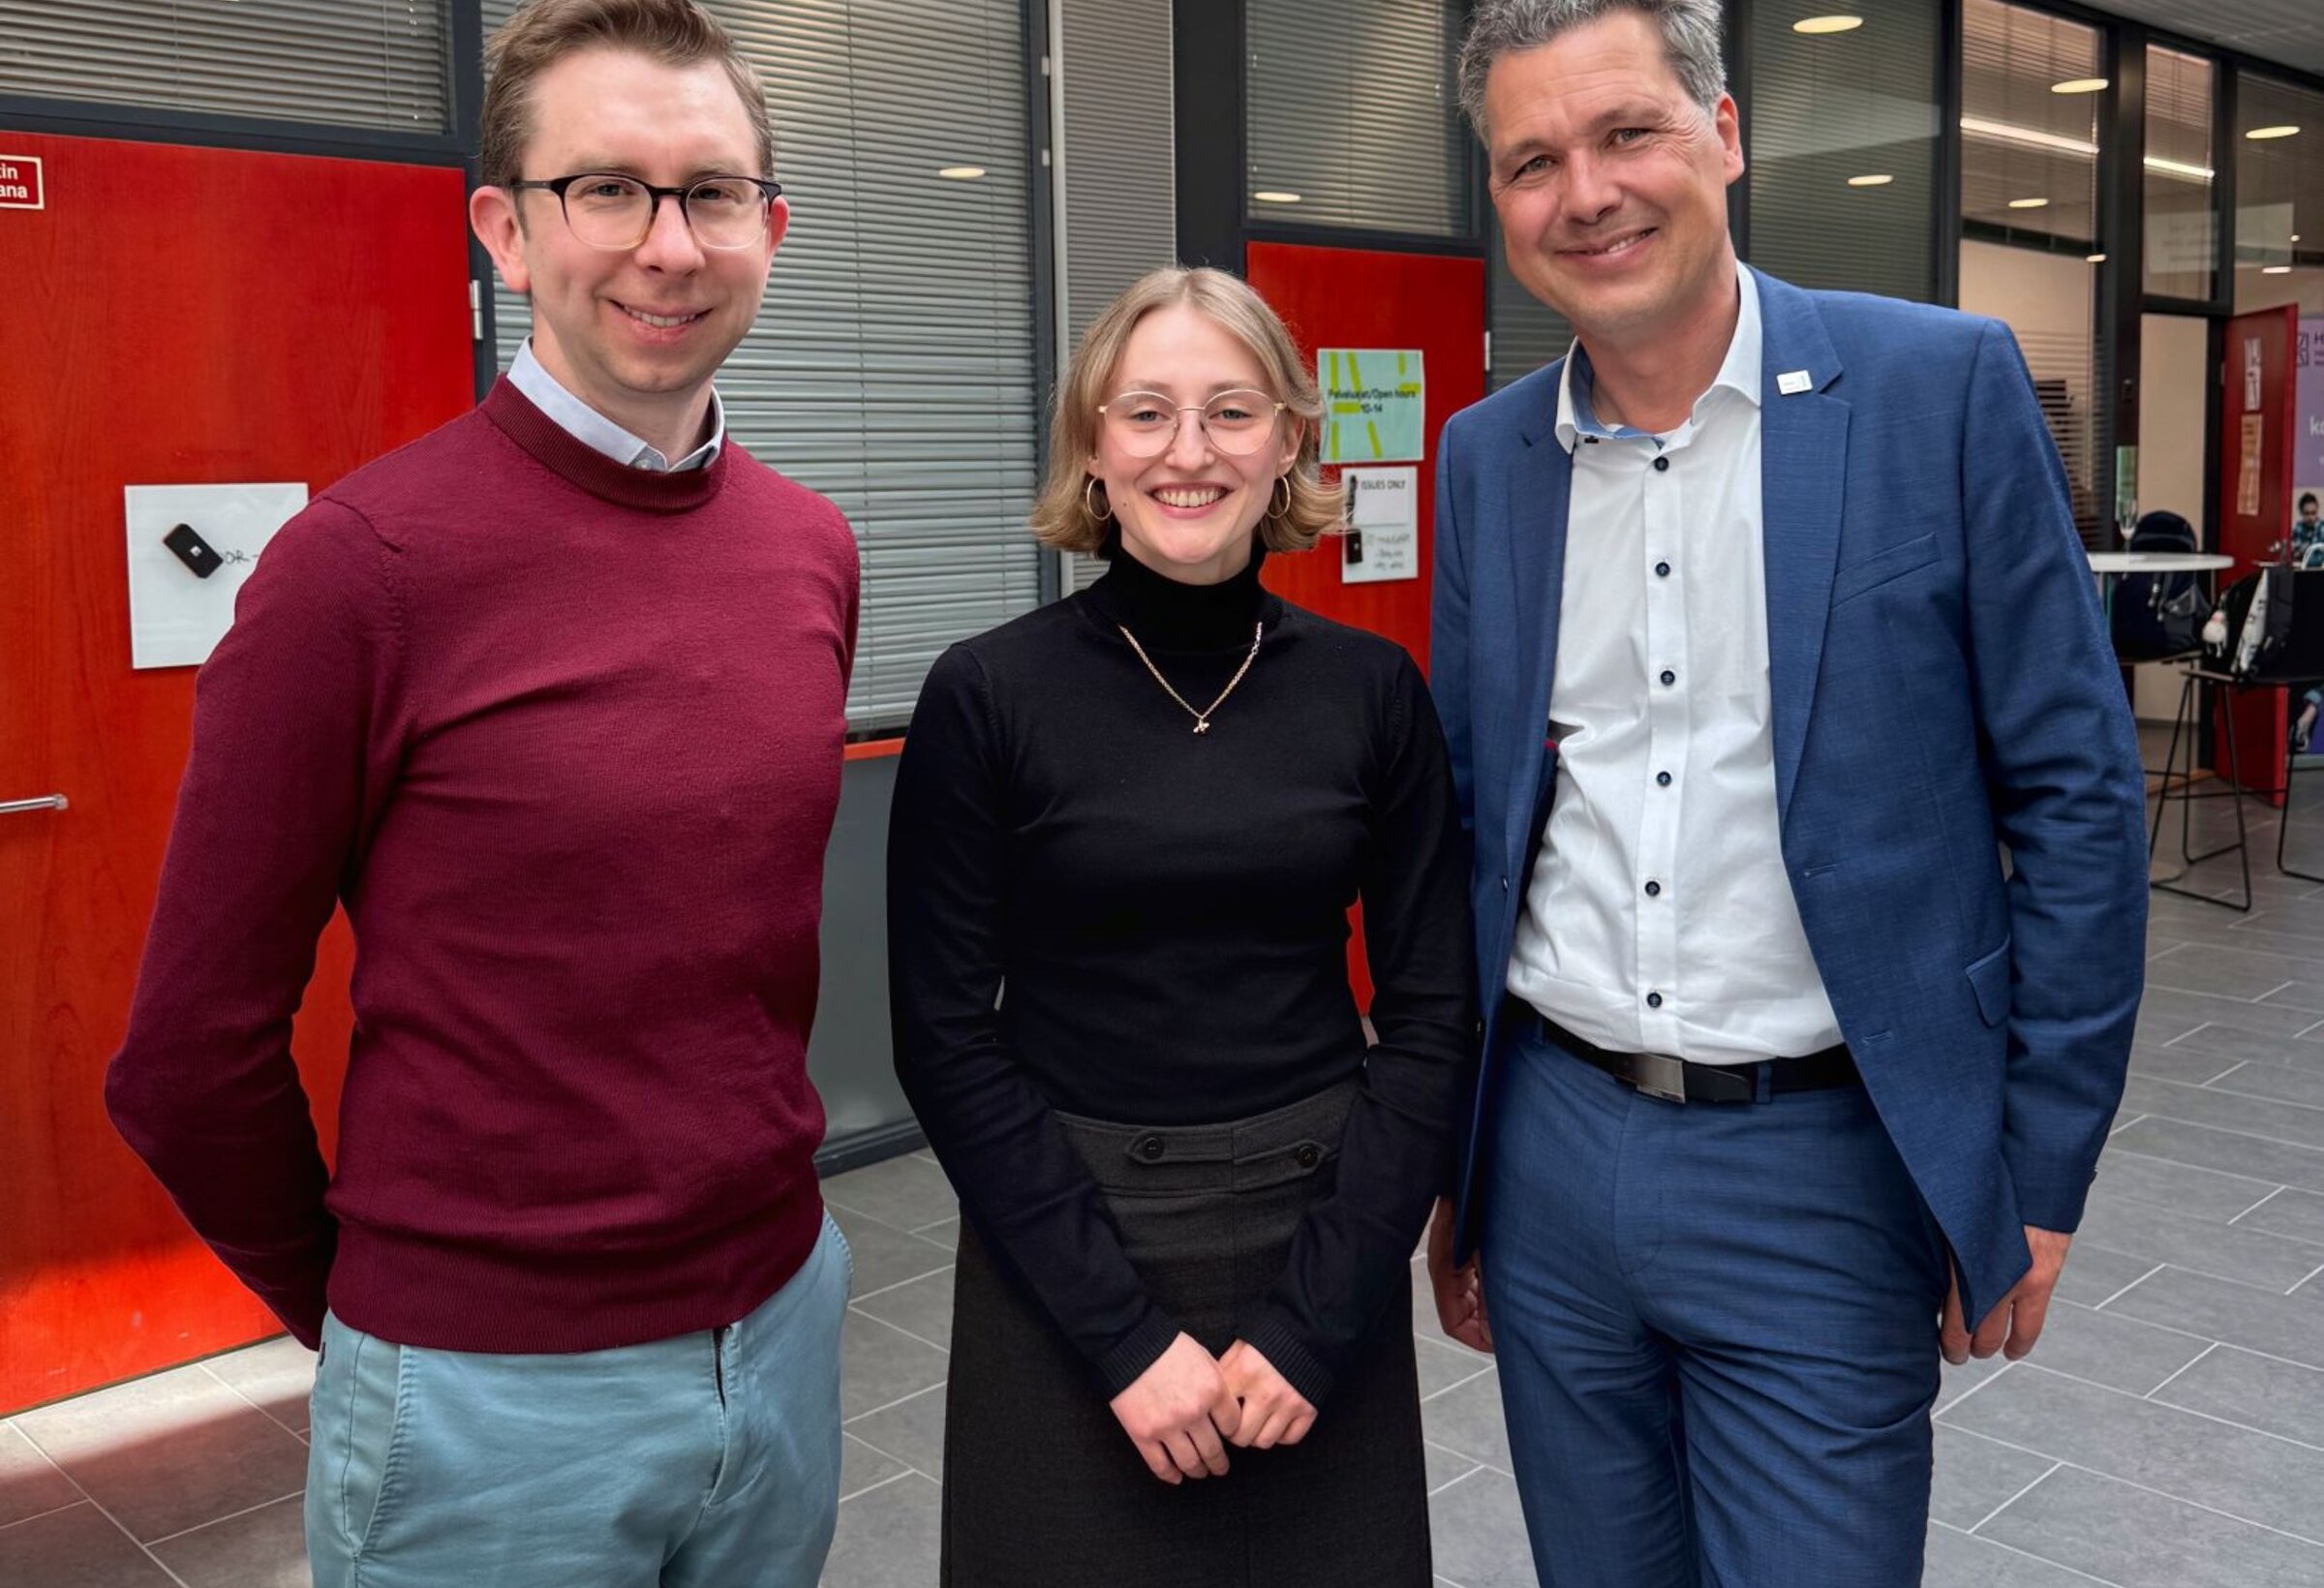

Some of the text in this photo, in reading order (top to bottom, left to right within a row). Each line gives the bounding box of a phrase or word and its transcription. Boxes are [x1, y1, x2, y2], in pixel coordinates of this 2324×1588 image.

[1394, 388, 1417, 399] hours
[1361, 479, 1406, 491] ISSUES ONLY
